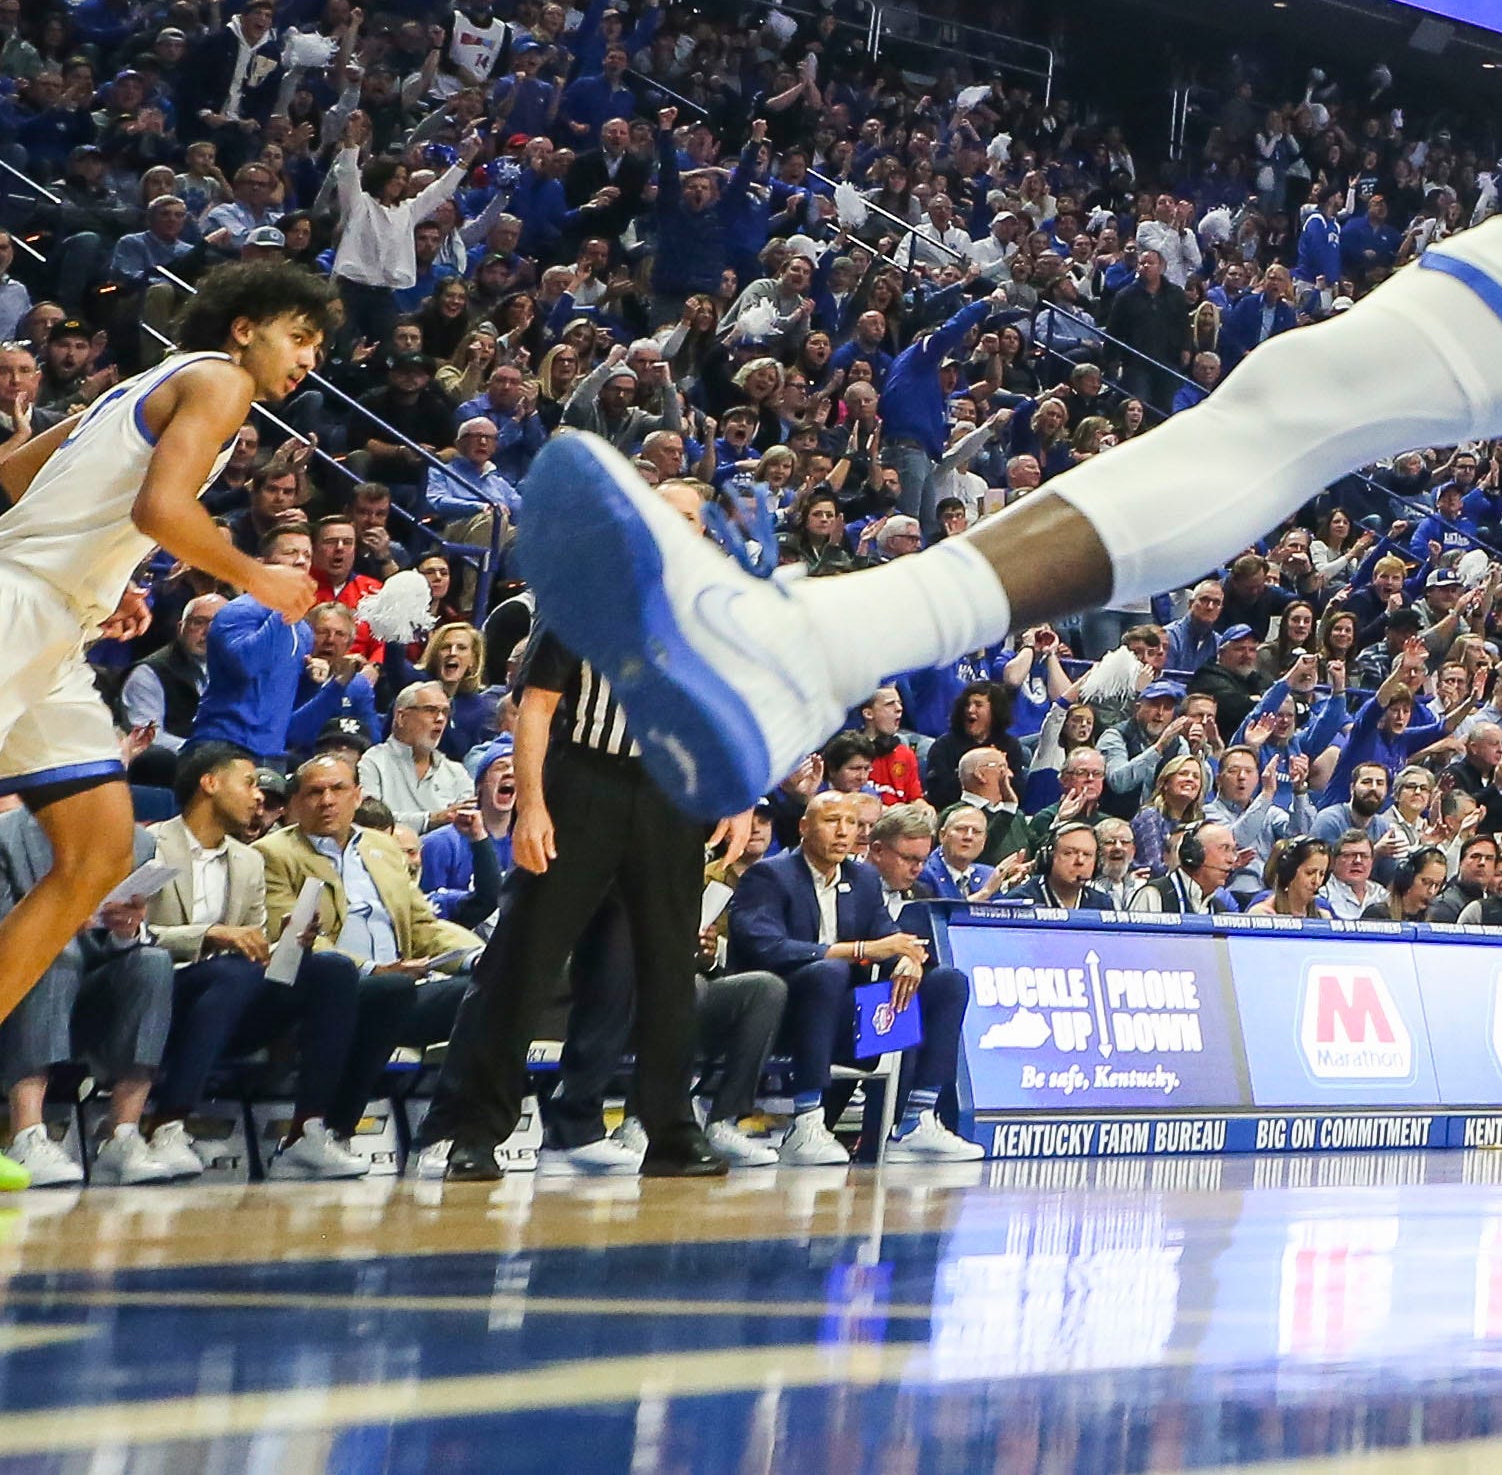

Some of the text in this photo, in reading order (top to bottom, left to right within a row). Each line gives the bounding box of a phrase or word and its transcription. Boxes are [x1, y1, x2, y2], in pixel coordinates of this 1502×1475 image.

[1212, 915, 1251, 928] KENTUCKY
[972, 966, 1089, 1009] BUCKLE
[1105, 968, 1199, 1011] PHONE
[1316, 977, 1396, 1043] M
[1050, 1011, 1093, 1053] UP
[1112, 1011, 1204, 1052] DOWN
[1021, 1063, 1180, 1095] Be safe, Kentucky.
[1316, 1050, 1403, 1070] Marathon
[992, 1124, 1094, 1158] KENTUCKY
[1098, 1122, 1155, 1153] FARM
[1155, 1121, 1228, 1153] BUREAU
[1256, 1120, 1288, 1150] BIG
[1290, 1119, 1316, 1149] ON
[1320, 1117, 1432, 1148] COMMITMENT
